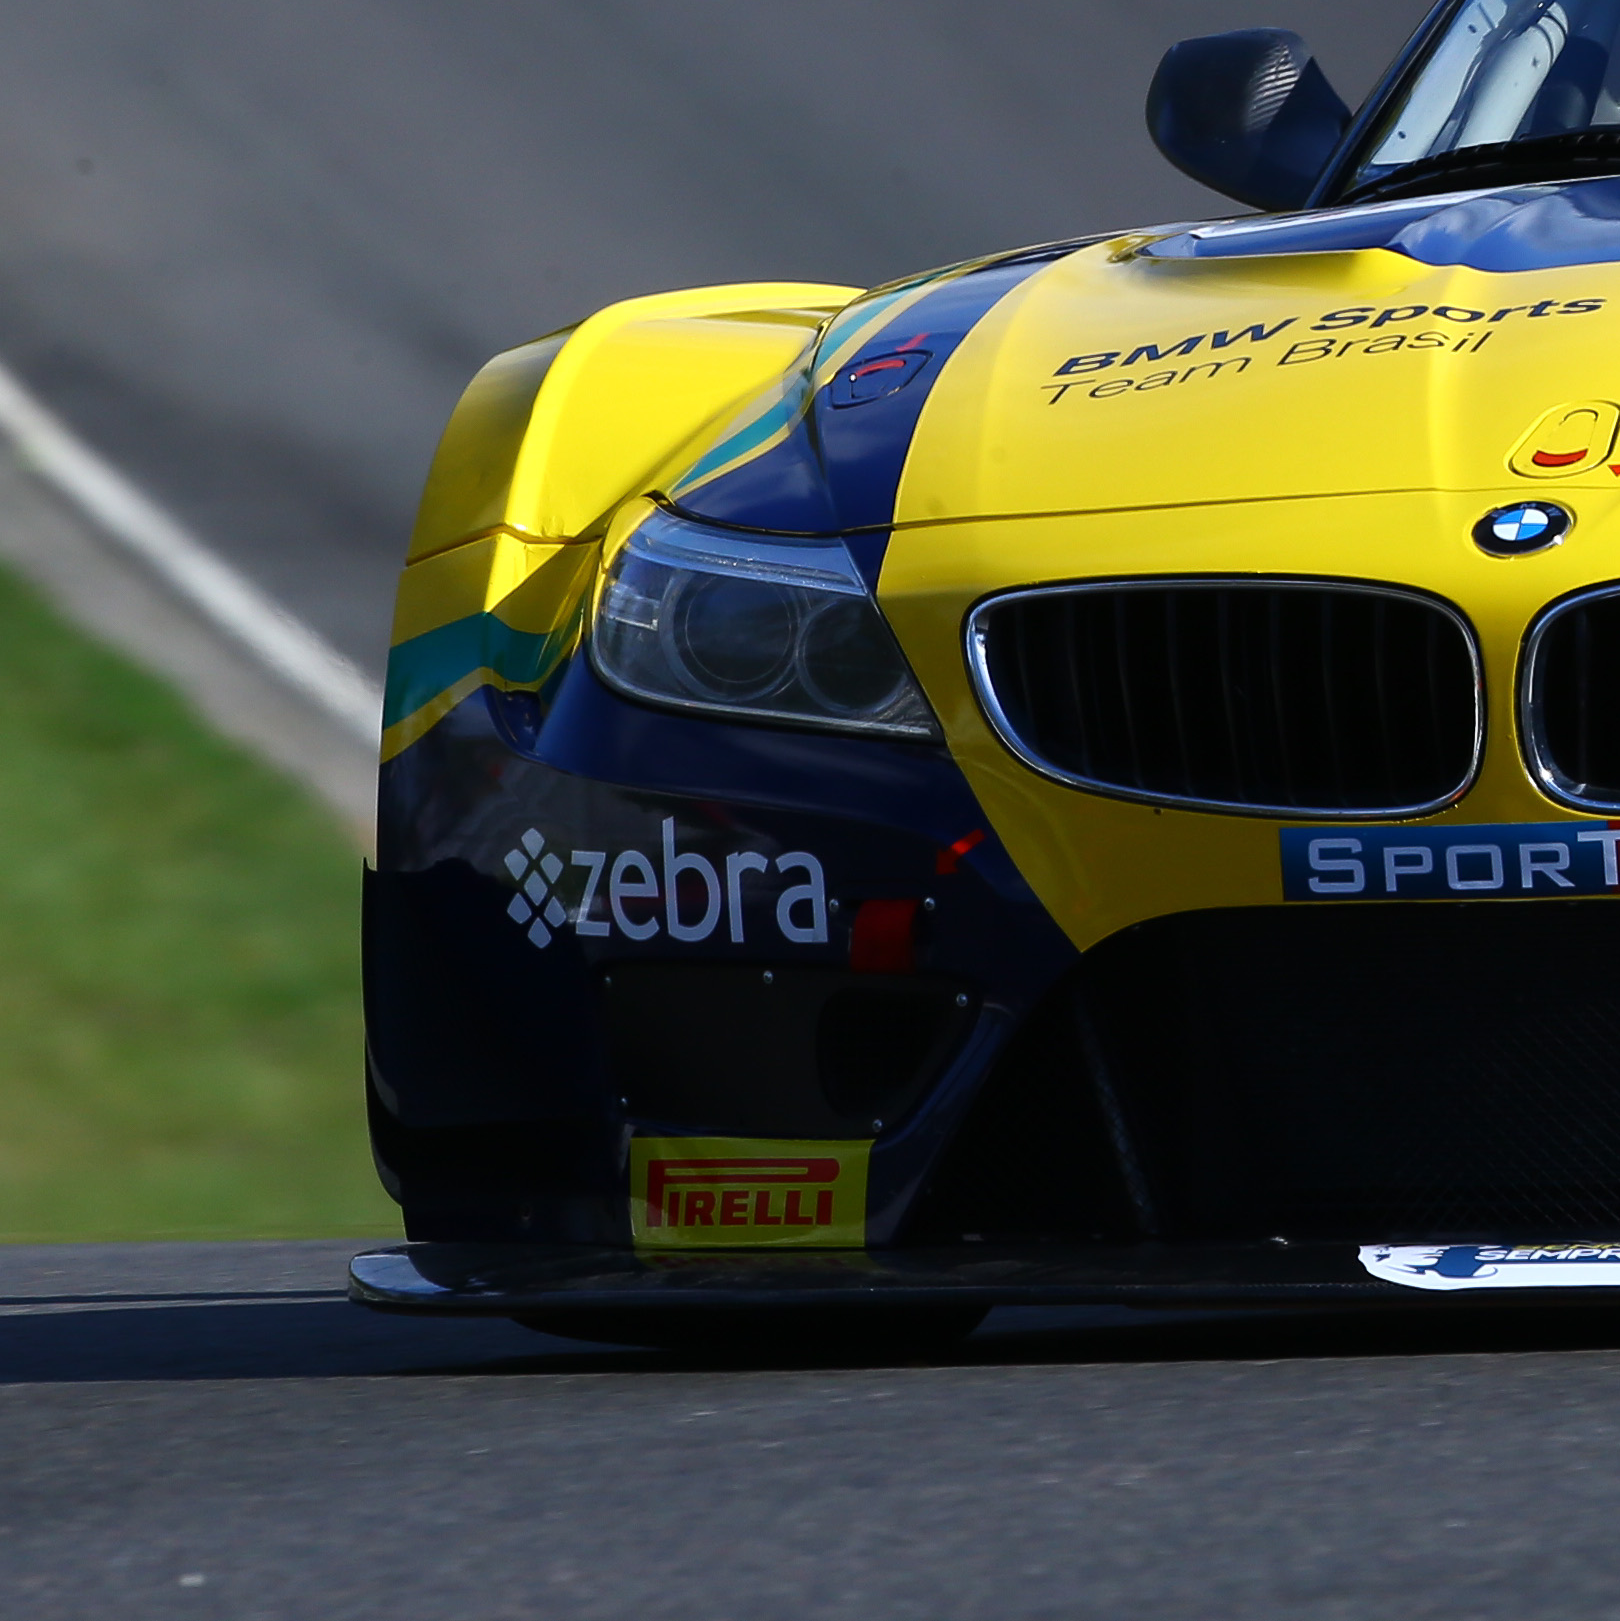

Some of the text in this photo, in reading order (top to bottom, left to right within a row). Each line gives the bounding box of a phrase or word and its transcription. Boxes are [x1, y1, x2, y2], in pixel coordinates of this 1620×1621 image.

[1040, 330, 1494, 405] Team Brasil
[1052, 315, 1301, 377] BMW
[1309, 297, 1608, 332] Sports
[570, 815, 829, 943] zebra
[646, 1157, 841, 1228] PIRELLI
